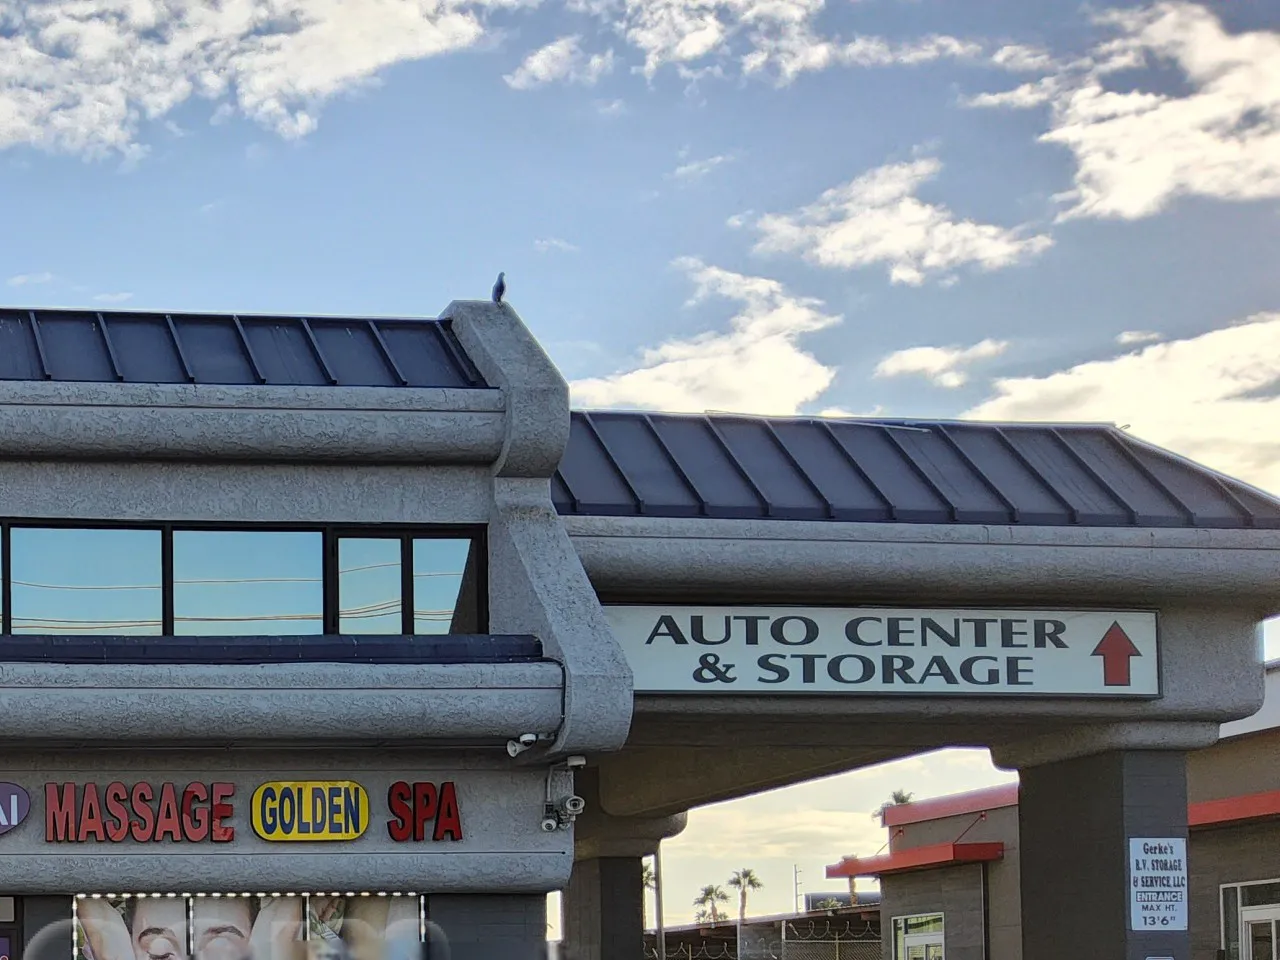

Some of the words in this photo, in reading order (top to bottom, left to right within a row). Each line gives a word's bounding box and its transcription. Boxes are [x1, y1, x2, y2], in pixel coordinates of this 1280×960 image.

[645, 614, 820, 646] AUTO
[844, 616, 1069, 649] CENTER
[692, 652, 738, 684] &
[757, 653, 1034, 687] STORAGE
[44, 781, 236, 842] MASSAGE
[260, 786, 361, 835] GOLDEN
[387, 781, 464, 842] SPA
[1151, 859, 1182, 871] STORAGE
[1173, 876, 1186, 888] LLC
[1137, 892, 1183, 902] ENTRANCE
[1141, 904, 1161, 912] MAX
[1165, 904, 1177, 912] HT.
